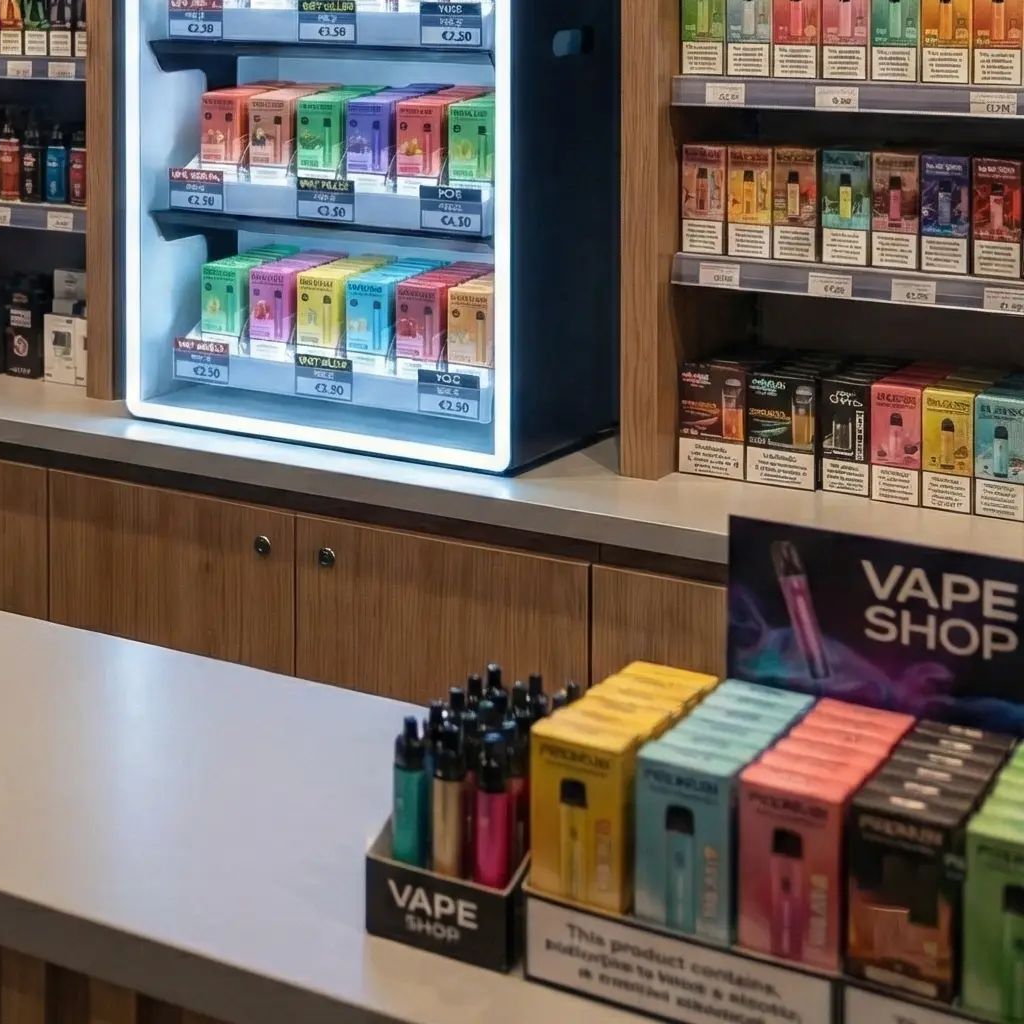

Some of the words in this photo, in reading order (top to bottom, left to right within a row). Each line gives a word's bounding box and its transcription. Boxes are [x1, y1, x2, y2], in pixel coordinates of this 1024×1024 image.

[860, 559, 1019, 623] VAPE
[863, 605, 1019, 661] SHOP
[387, 878, 478, 930] VAPE
[404, 913, 460, 942] SHOP
[566, 923, 606, 947] This
[610, 938, 686, 971] product
